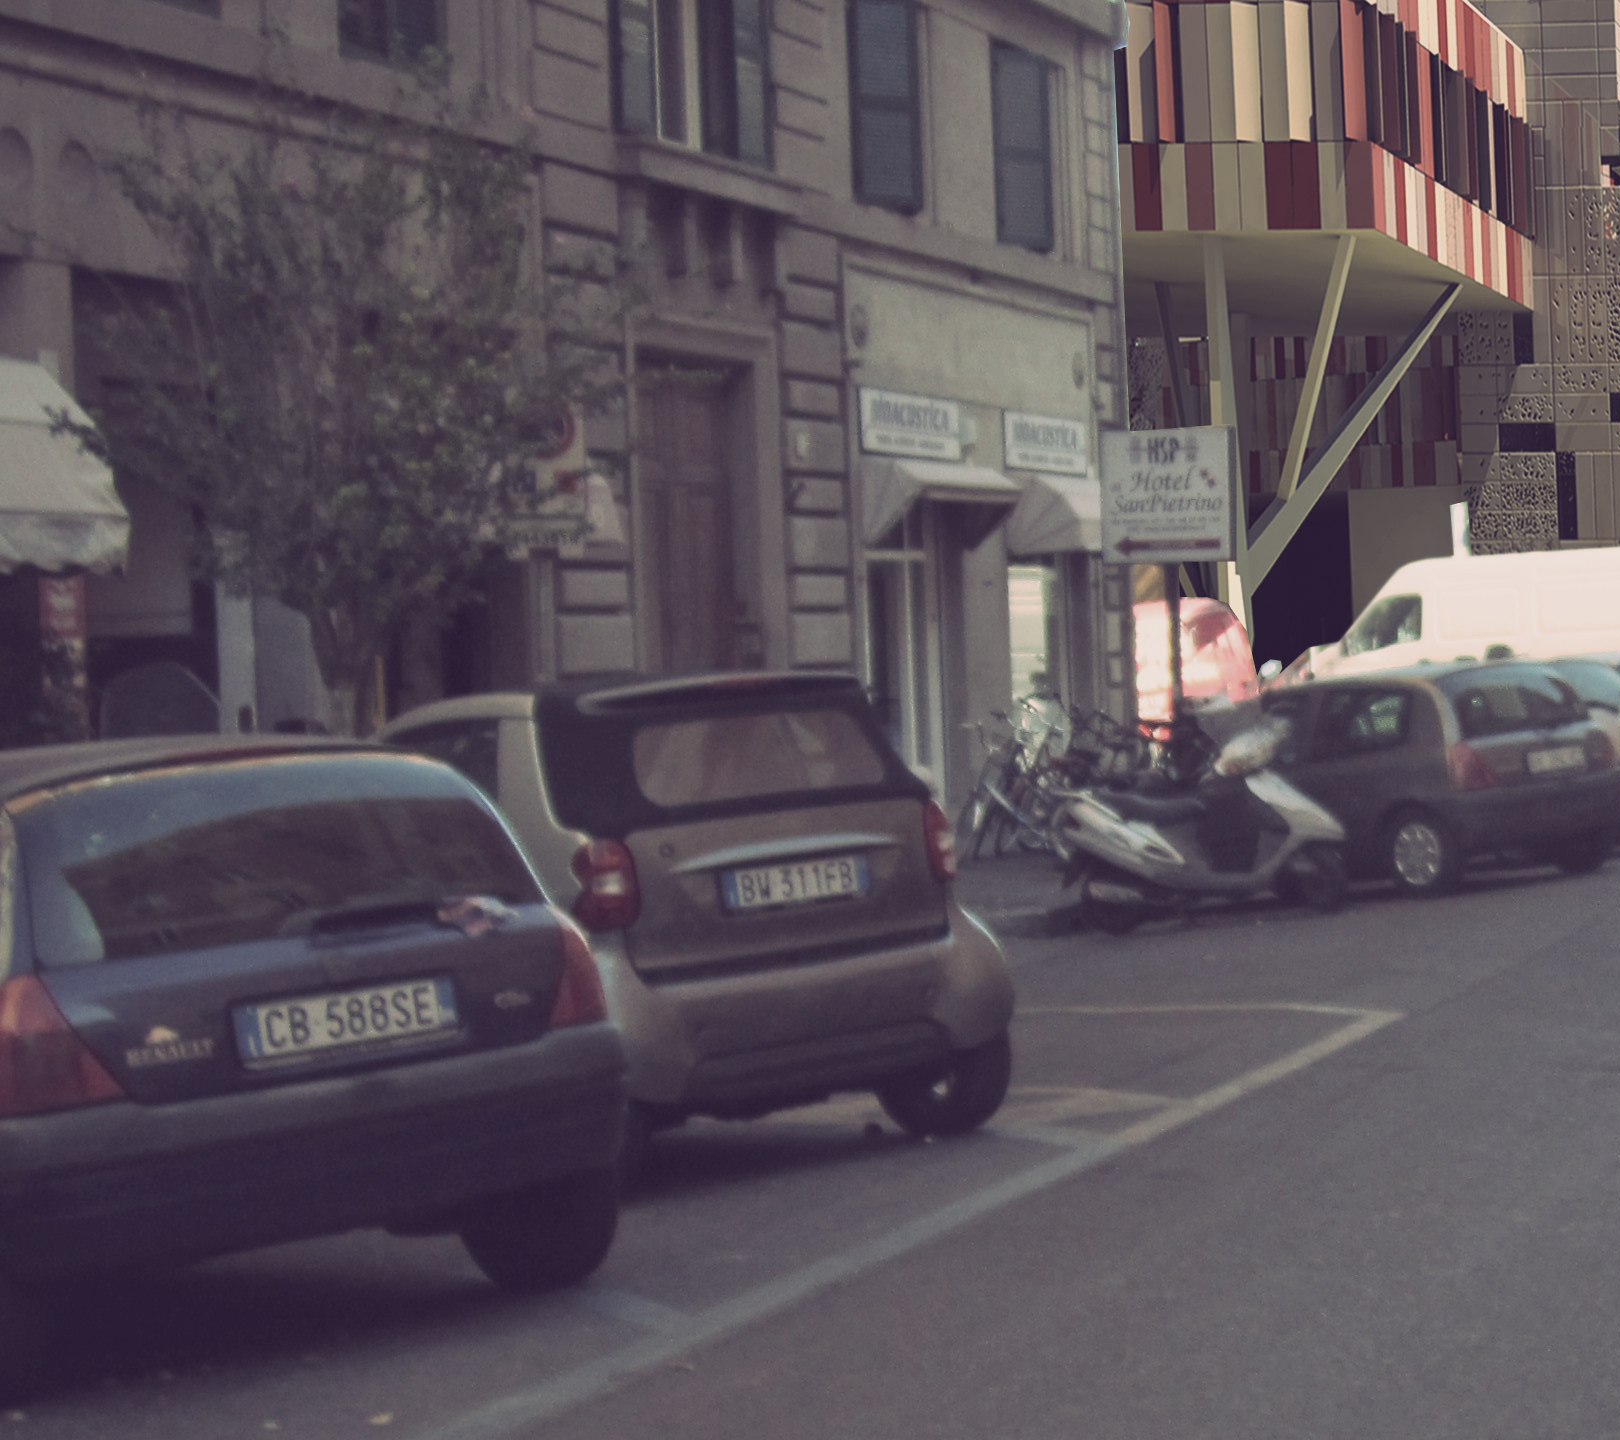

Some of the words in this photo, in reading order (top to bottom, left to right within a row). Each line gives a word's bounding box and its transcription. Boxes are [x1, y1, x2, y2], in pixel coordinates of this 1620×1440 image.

[1146, 436, 1180, 464] HSP
[1129, 465, 1195, 493] Hotel
[741, 871, 771, 903] BW
[265, 1006, 311, 1048] CB
[325, 987, 433, 1038] 588SE
